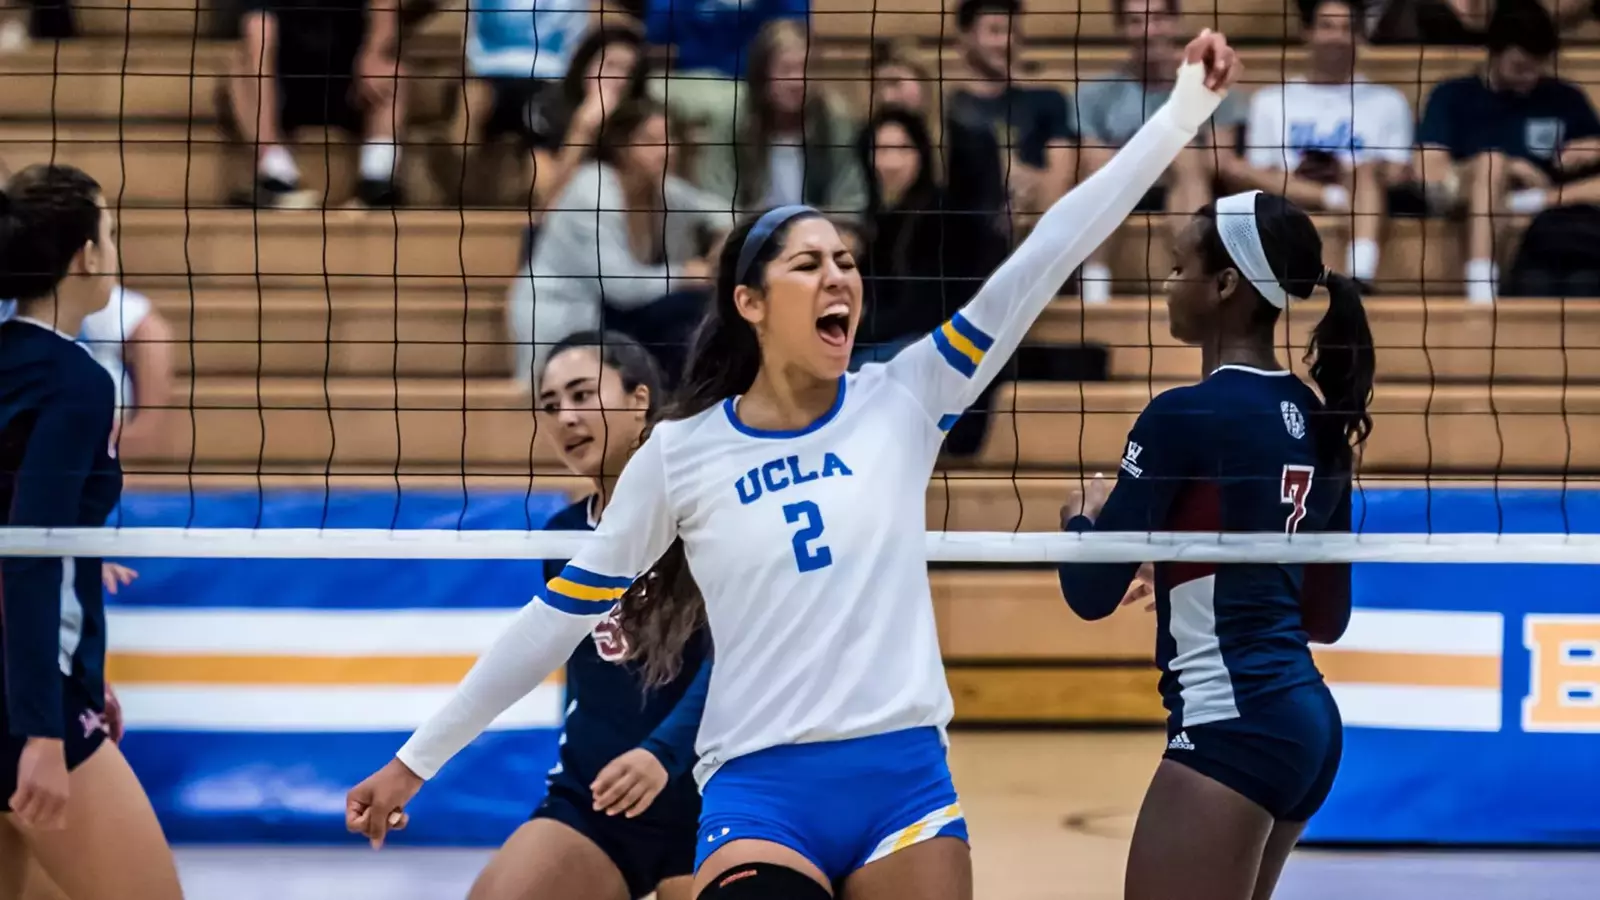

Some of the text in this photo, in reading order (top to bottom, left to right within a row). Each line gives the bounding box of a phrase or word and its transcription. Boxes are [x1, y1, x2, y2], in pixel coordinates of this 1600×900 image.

[735, 452, 853, 505] UCLA
[1281, 464, 1315, 534] 7
[782, 500, 832, 573] 2
